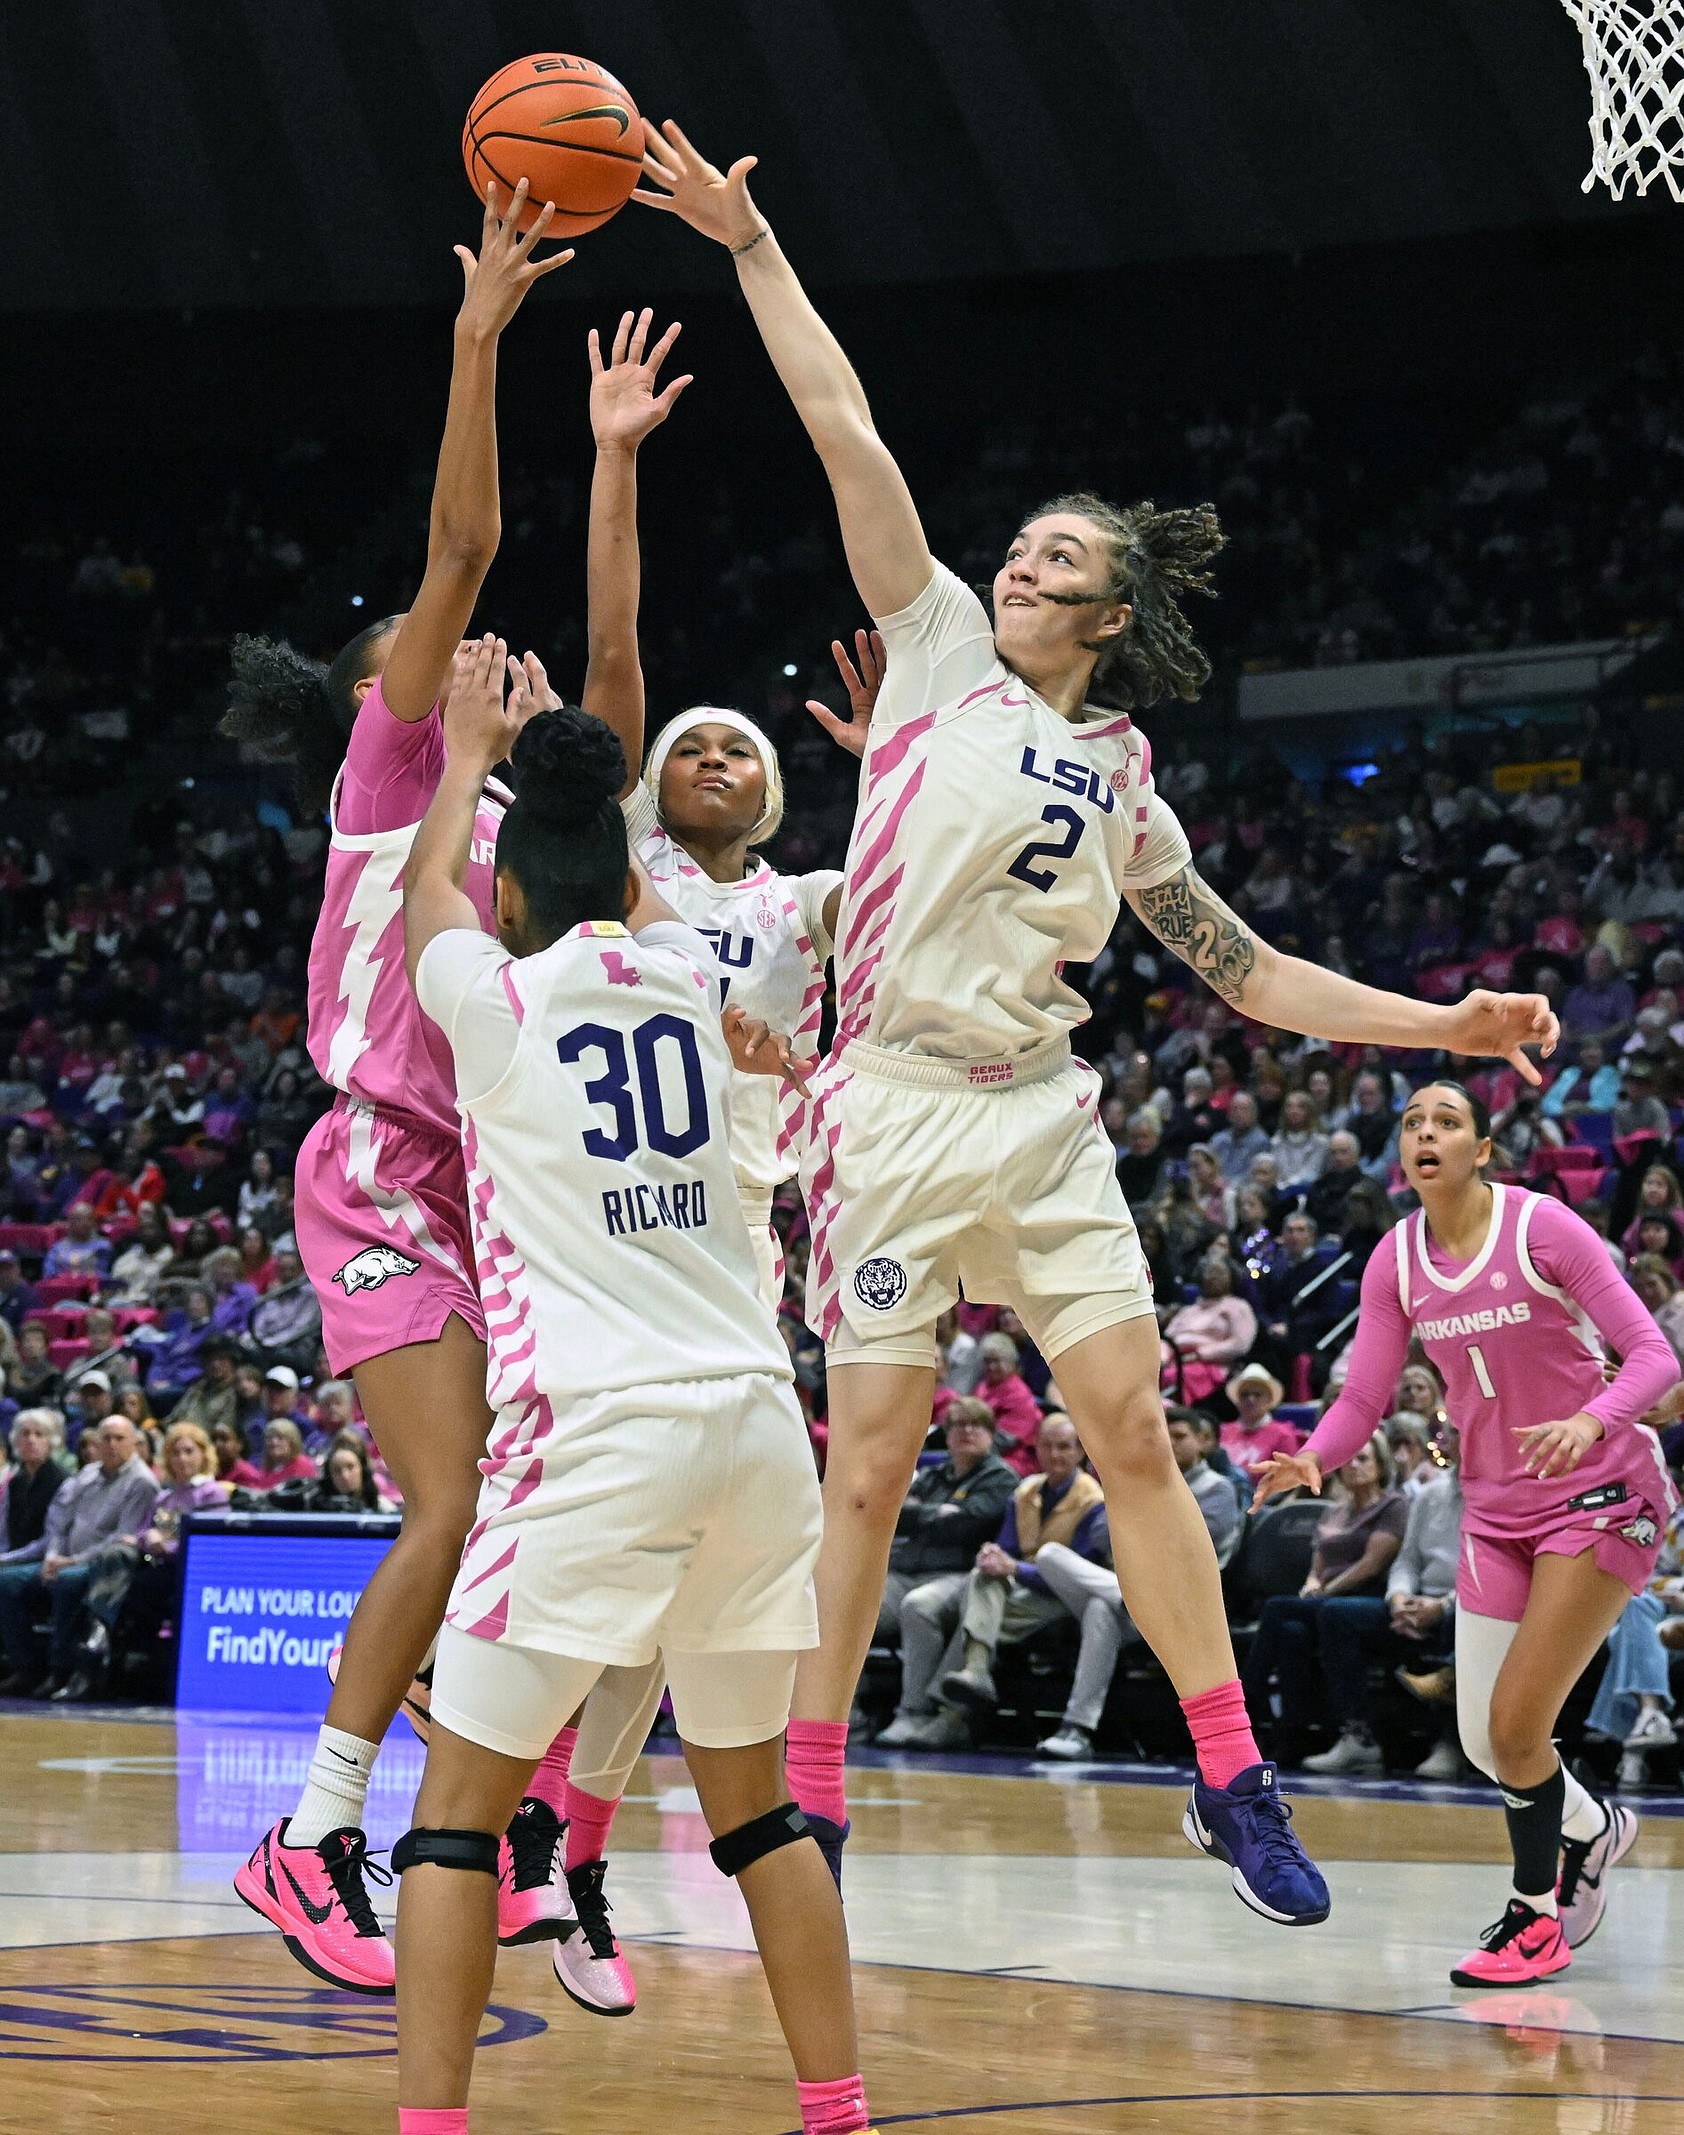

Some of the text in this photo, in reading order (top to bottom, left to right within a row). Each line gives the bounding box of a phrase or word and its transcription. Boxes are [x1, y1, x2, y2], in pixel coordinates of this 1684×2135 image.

[1020, 745, 1114, 814] LSU
[1006, 804, 1086, 894] 2
[1193, 920, 1217, 969] 2
[556, 1013, 711, 1162] 30
[968, 1071, 1014, 1084] TIGERS
[970, 1062, 1013, 1075] GEAUX
[1414, 1301, 1532, 1341] ARKANSAS
[1466, 1345, 1498, 1399] 1
[200, 1586, 255, 1615] PLAN
[257, 1588, 315, 1617] YOUR
